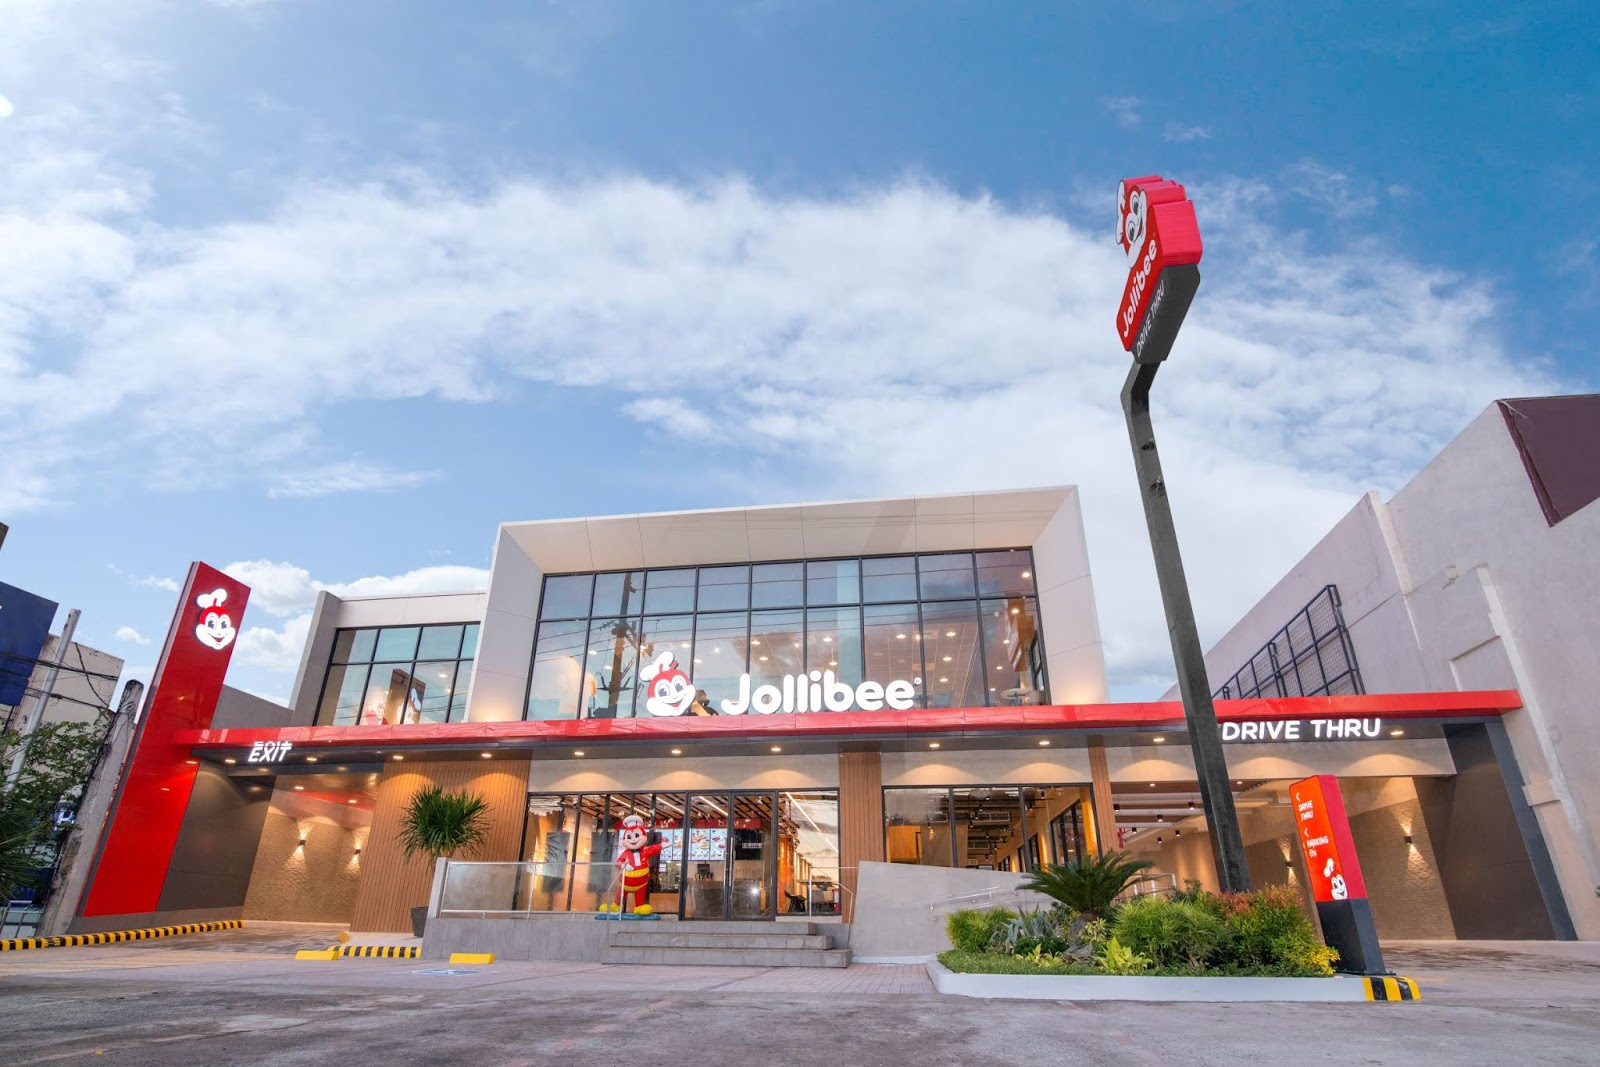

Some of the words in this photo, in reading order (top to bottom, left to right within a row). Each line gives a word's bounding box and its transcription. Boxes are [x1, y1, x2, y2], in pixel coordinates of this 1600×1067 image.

[1124, 239, 1157, 337] Jollibee
[1136, 314, 1152, 358] DRIVE
[1151, 280, 1165, 319] THRU
[720, 669, 914, 715] Jollibee
[1222, 720, 1300, 741] DRIVE
[1310, 718, 1381, 739] THRU
[247, 746, 292, 762] EXIT
[1298, 801, 1313, 811] DRIVE
[1300, 811, 1313, 820] THRU
[1306, 836, 1328, 847] PARKING
